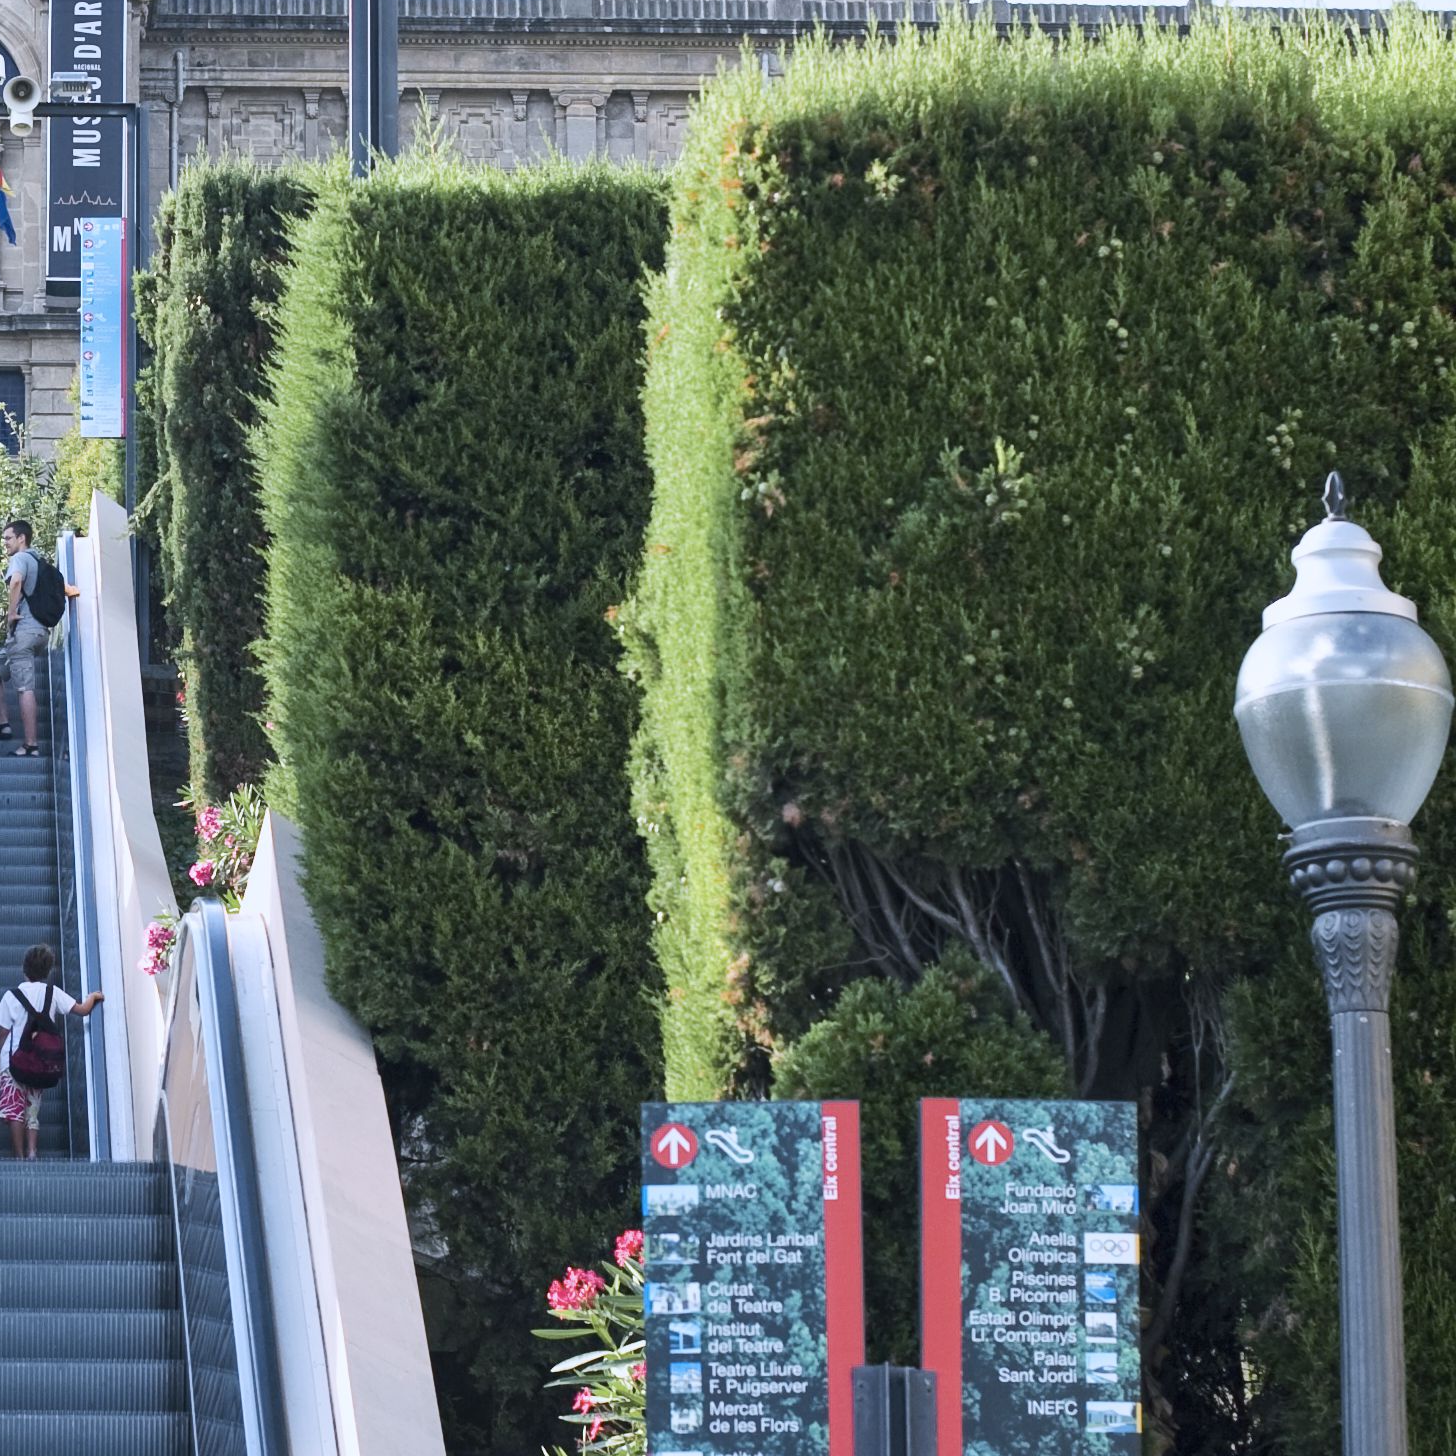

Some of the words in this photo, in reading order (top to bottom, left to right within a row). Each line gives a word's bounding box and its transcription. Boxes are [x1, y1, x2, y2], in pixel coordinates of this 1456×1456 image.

[822, 1116, 837, 1172] central
[945, 1115, 960, 1171] central
[705, 1184, 757, 1199] MNAC
[823, 1175, 838, 1200] Eix
[945, 1175, 960, 1200] Eix
[1005, 1182, 1076, 1198] Fundació
[999, 1200, 1037, 1215] Joan
[1042, 1199, 1076, 1215] Miró
[706, 1234, 762, 1247] Jardins
[767, 1233, 818, 1247] Laribal
[1029, 1231, 1076, 1246] Anella
[706, 1250, 742, 1264] Font
[746, 1249, 769, 1264] del
[774, 1249, 802, 1264] Gat
[1012, 1272, 1076, 1286] Piscines
[707, 1282, 754, 1296] Ciutat
[990, 1288, 1005, 1303] B.
[1010, 1288, 1076, 1303] Picornell
[707, 1298, 731, 1313] del
[736, 1298, 783, 1313] Teatre
[970, 1310, 1016, 1326] Estadi
[708, 1322, 761, 1336] Institut
[994, 1328, 1077, 1346] Companys
[709, 1338, 732, 1353] del
[737, 1338, 783, 1353] Teatre
[1034, 1352, 1076, 1366] Palau
[709, 1363, 755, 1377] Teatre
[761, 1362, 802, 1377] Lliure
[999, 1368, 1035, 1383] Sant
[1039, 1368, 1077, 1383] Jordi
[710, 1380, 721, 1393] F.
[726, 1380, 808, 1397] Puigserver
[710, 1401, 763, 1416] Mercat
[1027, 1400, 1078, 1415] INEFC
[709, 1418, 729, 1433] de
[734, 1418, 756, 1433] les
[761, 1418, 799, 1433] Flors
